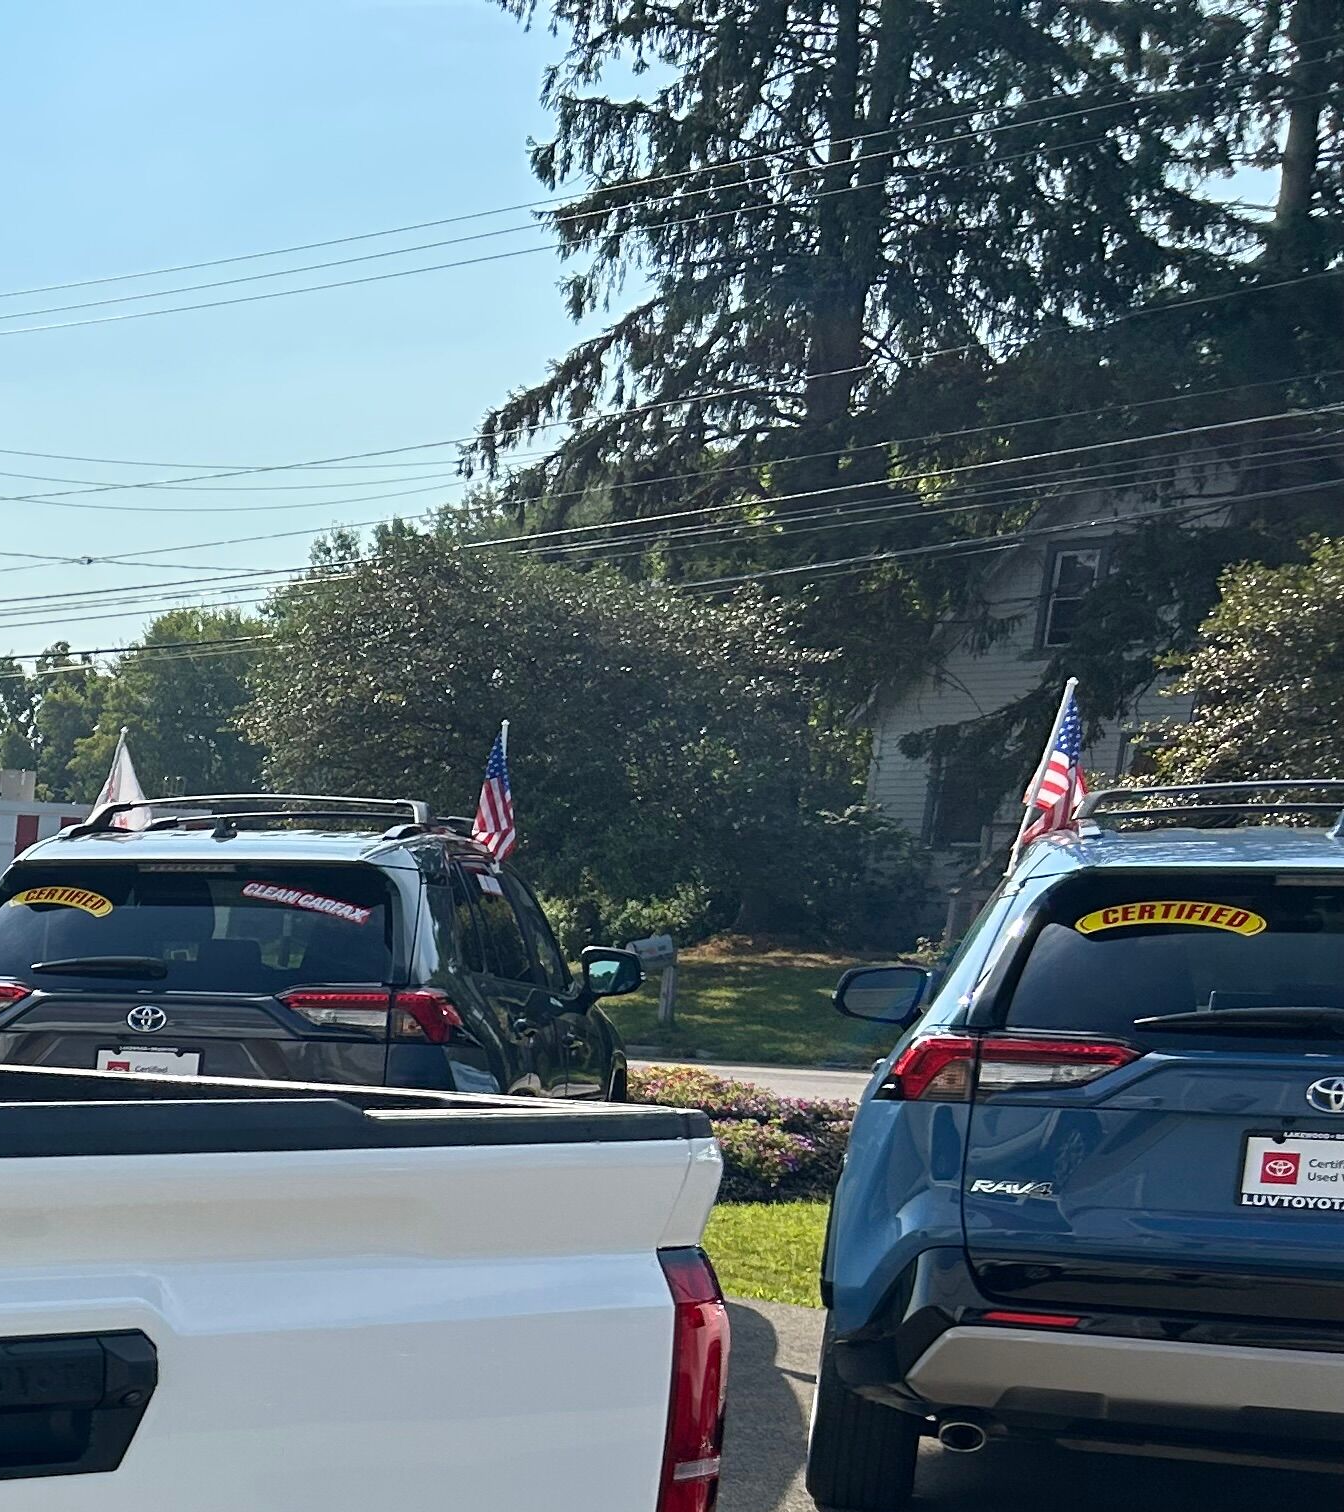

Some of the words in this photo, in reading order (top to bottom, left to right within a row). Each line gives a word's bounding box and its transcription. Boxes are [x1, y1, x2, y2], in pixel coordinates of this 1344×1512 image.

[25, 888, 107, 911] CERTIFIED
[242, 882, 301, 905] CLEAN
[298, 893, 372, 923] CARFAX
[1102, 903, 1250, 928] CERTIFIED
[1308, 1158, 1344, 1169] Certif
[1307, 1172, 1339, 1182] Used
[970, 1179, 1053, 1197] RAV4
